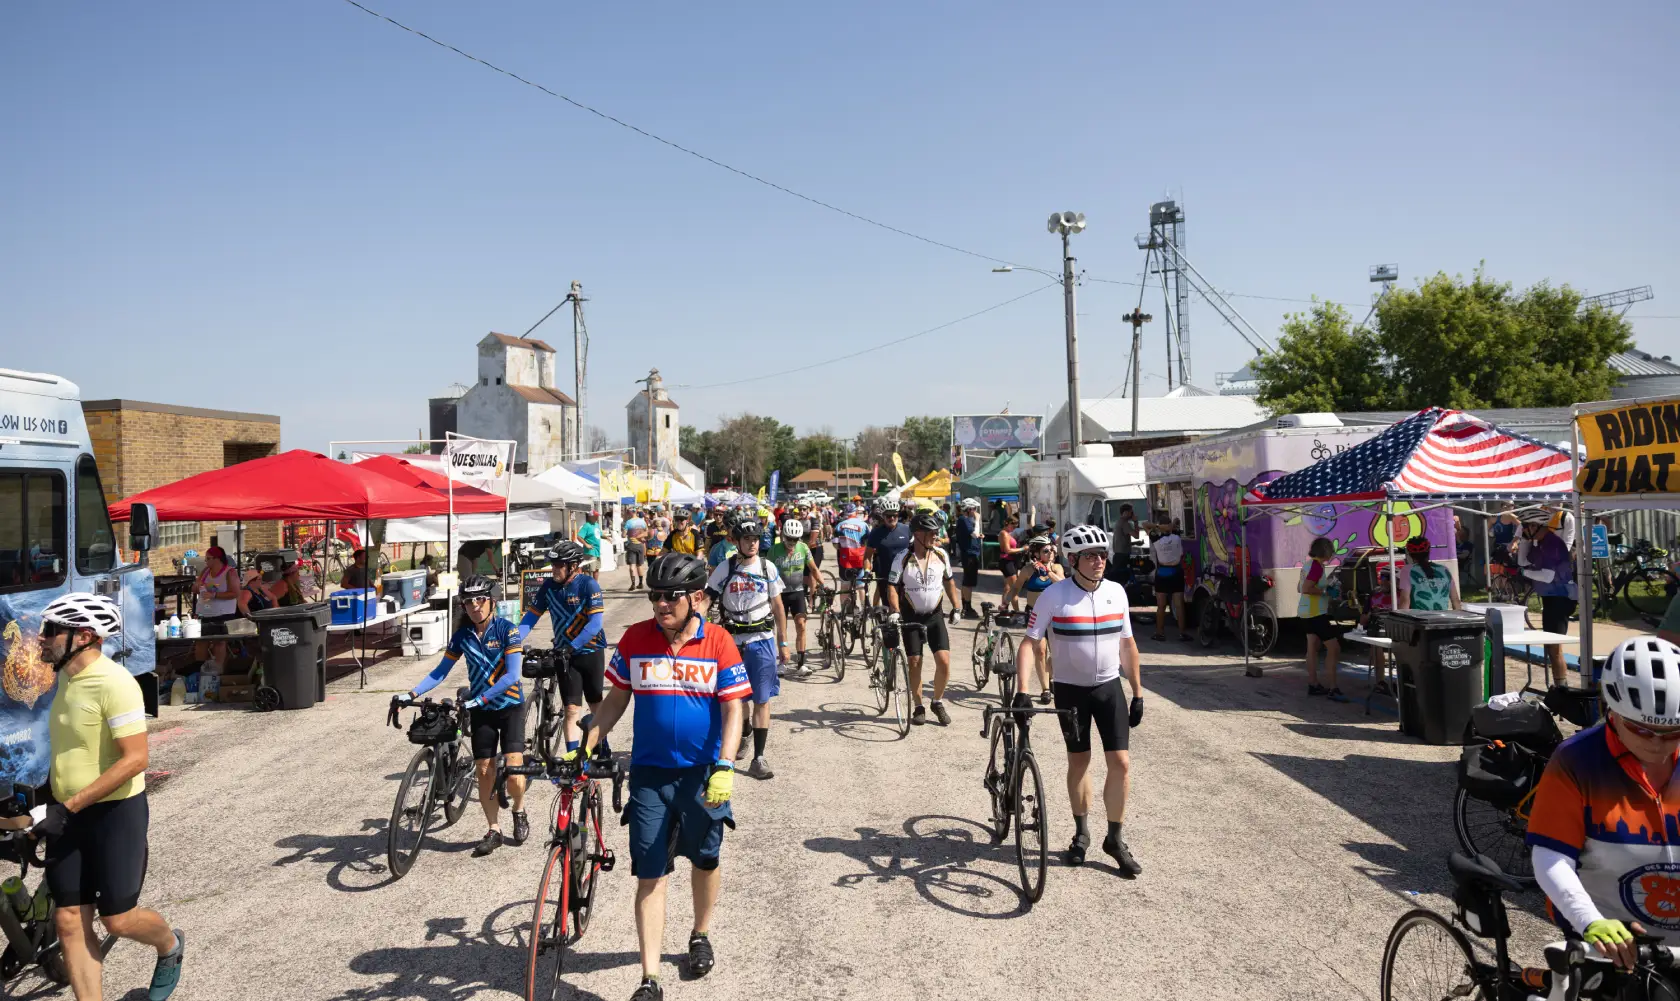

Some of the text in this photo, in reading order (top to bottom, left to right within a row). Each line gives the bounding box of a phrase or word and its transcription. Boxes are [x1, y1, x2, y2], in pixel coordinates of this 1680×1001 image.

[24, 416, 38, 431] US
[40, 418, 55, 433] ON
[451, 452, 497, 468] QUESDILLAS
[1583, 452, 1676, 492] THAT
[775, 551, 804, 568] GRVEL
[639, 661, 715, 683] TOSRV
[730, 664, 747, 675] TOS
